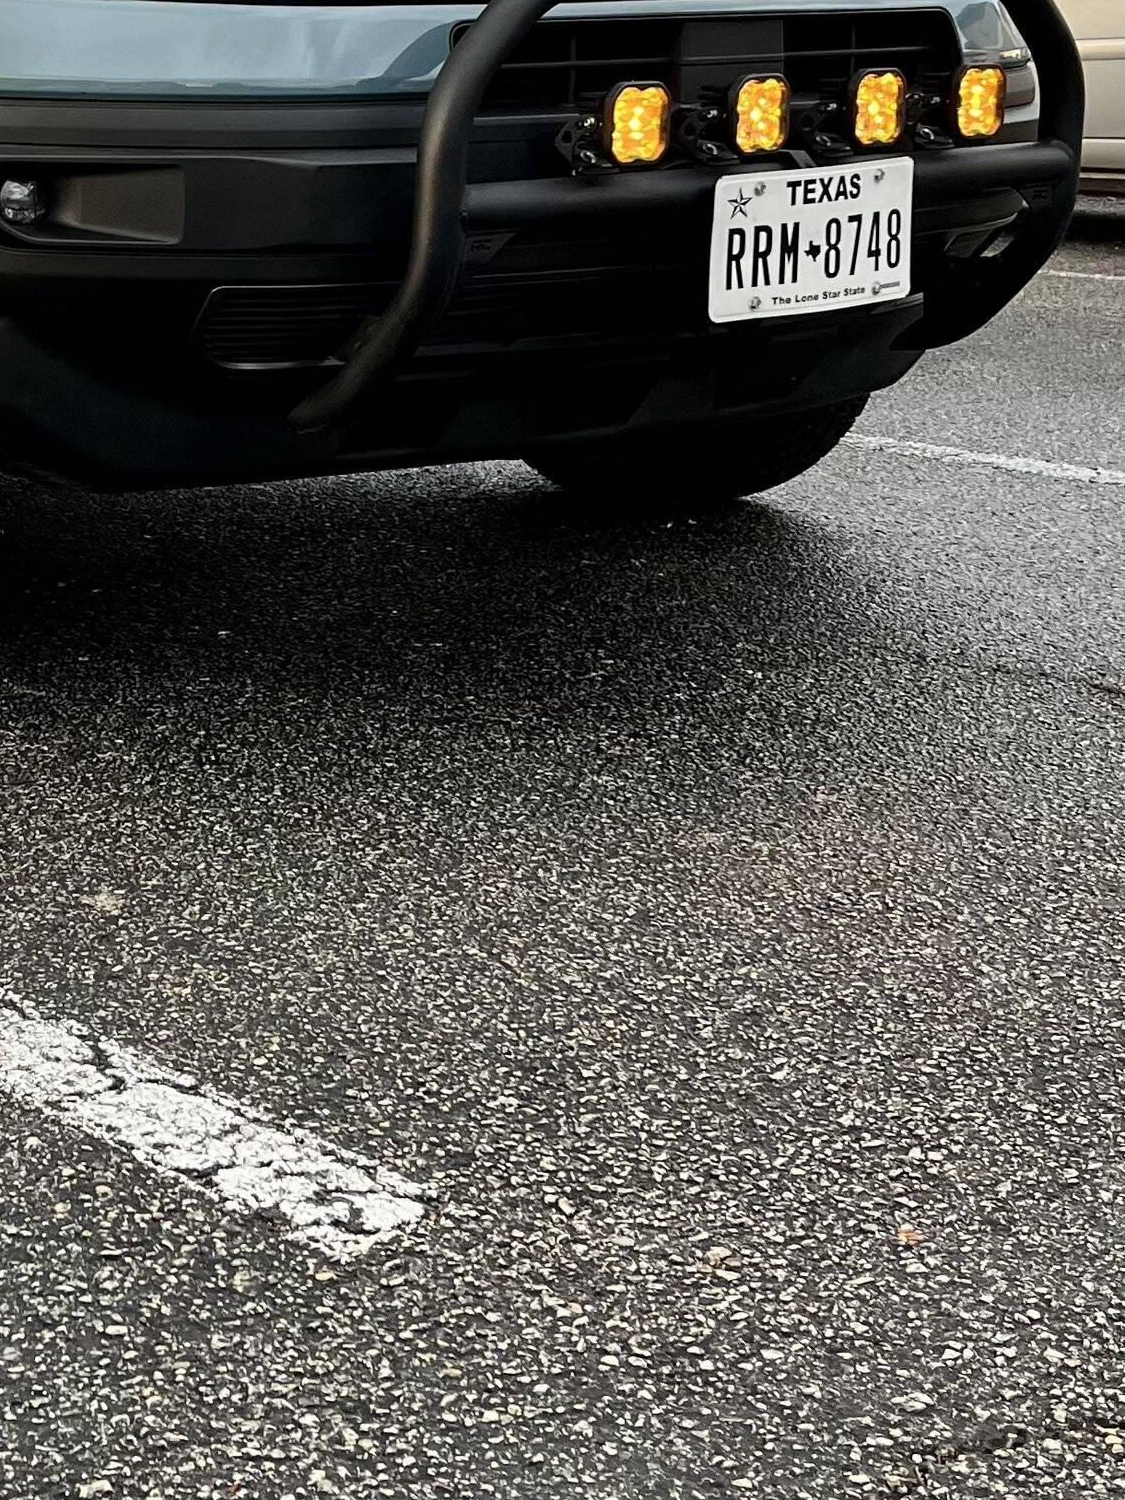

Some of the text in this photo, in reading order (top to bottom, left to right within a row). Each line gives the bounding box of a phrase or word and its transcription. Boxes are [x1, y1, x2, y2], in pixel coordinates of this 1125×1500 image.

[786, 173, 861, 206] TEXAS
[771, 286, 865, 305] The Lone Star State
